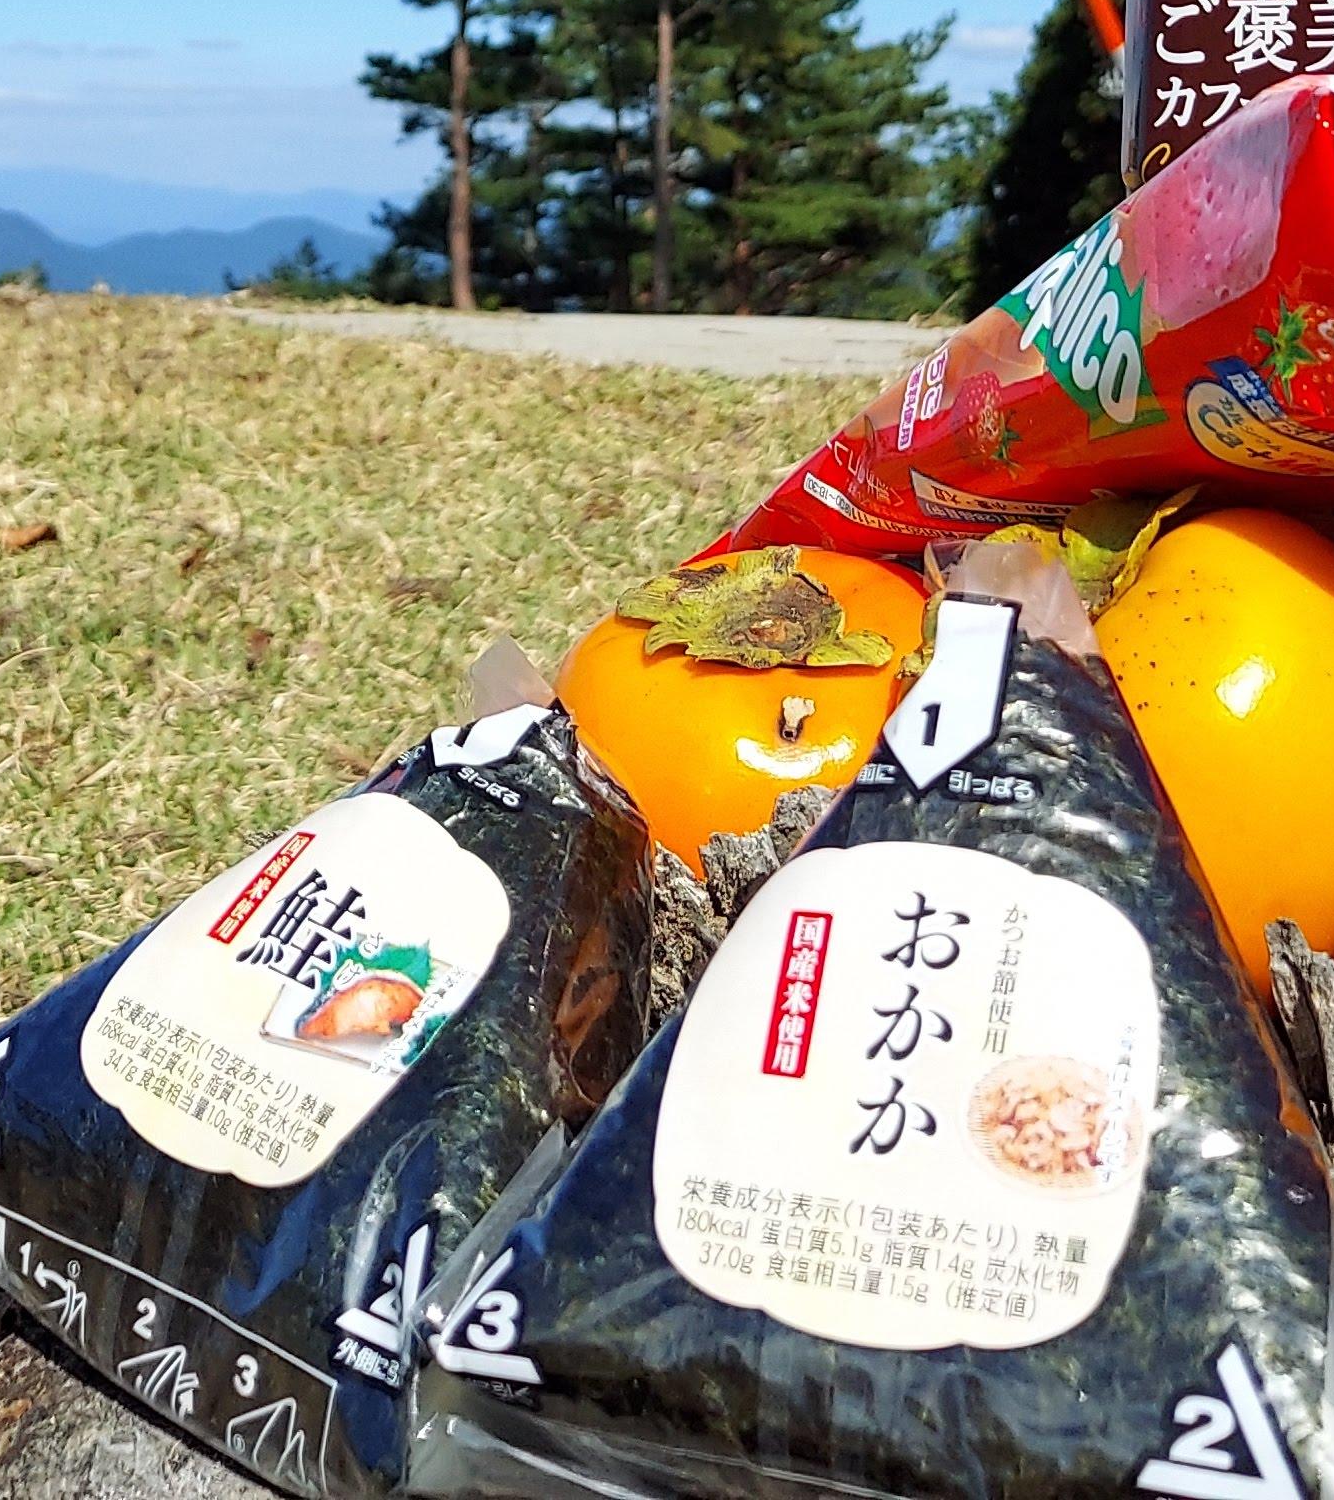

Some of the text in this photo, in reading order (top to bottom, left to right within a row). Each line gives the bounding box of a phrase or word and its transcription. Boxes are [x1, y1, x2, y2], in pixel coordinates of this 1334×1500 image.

[1153, 76, 1252, 129] カフ
[921, 700, 942, 747] 1
[457, 765, 522, 808] 引っぱる
[947, 768, 1037, 802] 引っぱる
[235, 867, 367, 990] 鮭
[769, 914, 828, 1077] 国産米使用
[981, 902, 1028, 1055] かつお節使用
[848, 890, 971, 1156] おかか
[676, 1206, 751, 1240] 180kcal
[984, 1255, 1081, 1296] 炭水化物
[1032, 1229, 1089, 1265] 熱量
[698, 1240, 756, 1276] 37.0g
[946, 1279, 1038, 1323] (推定値)
[132, 1297, 157, 1341] 2
[466, 1289, 519, 1353] 3
[233, 1353, 259, 1398] 3
[1168, 1394, 1237, 1471] 2
